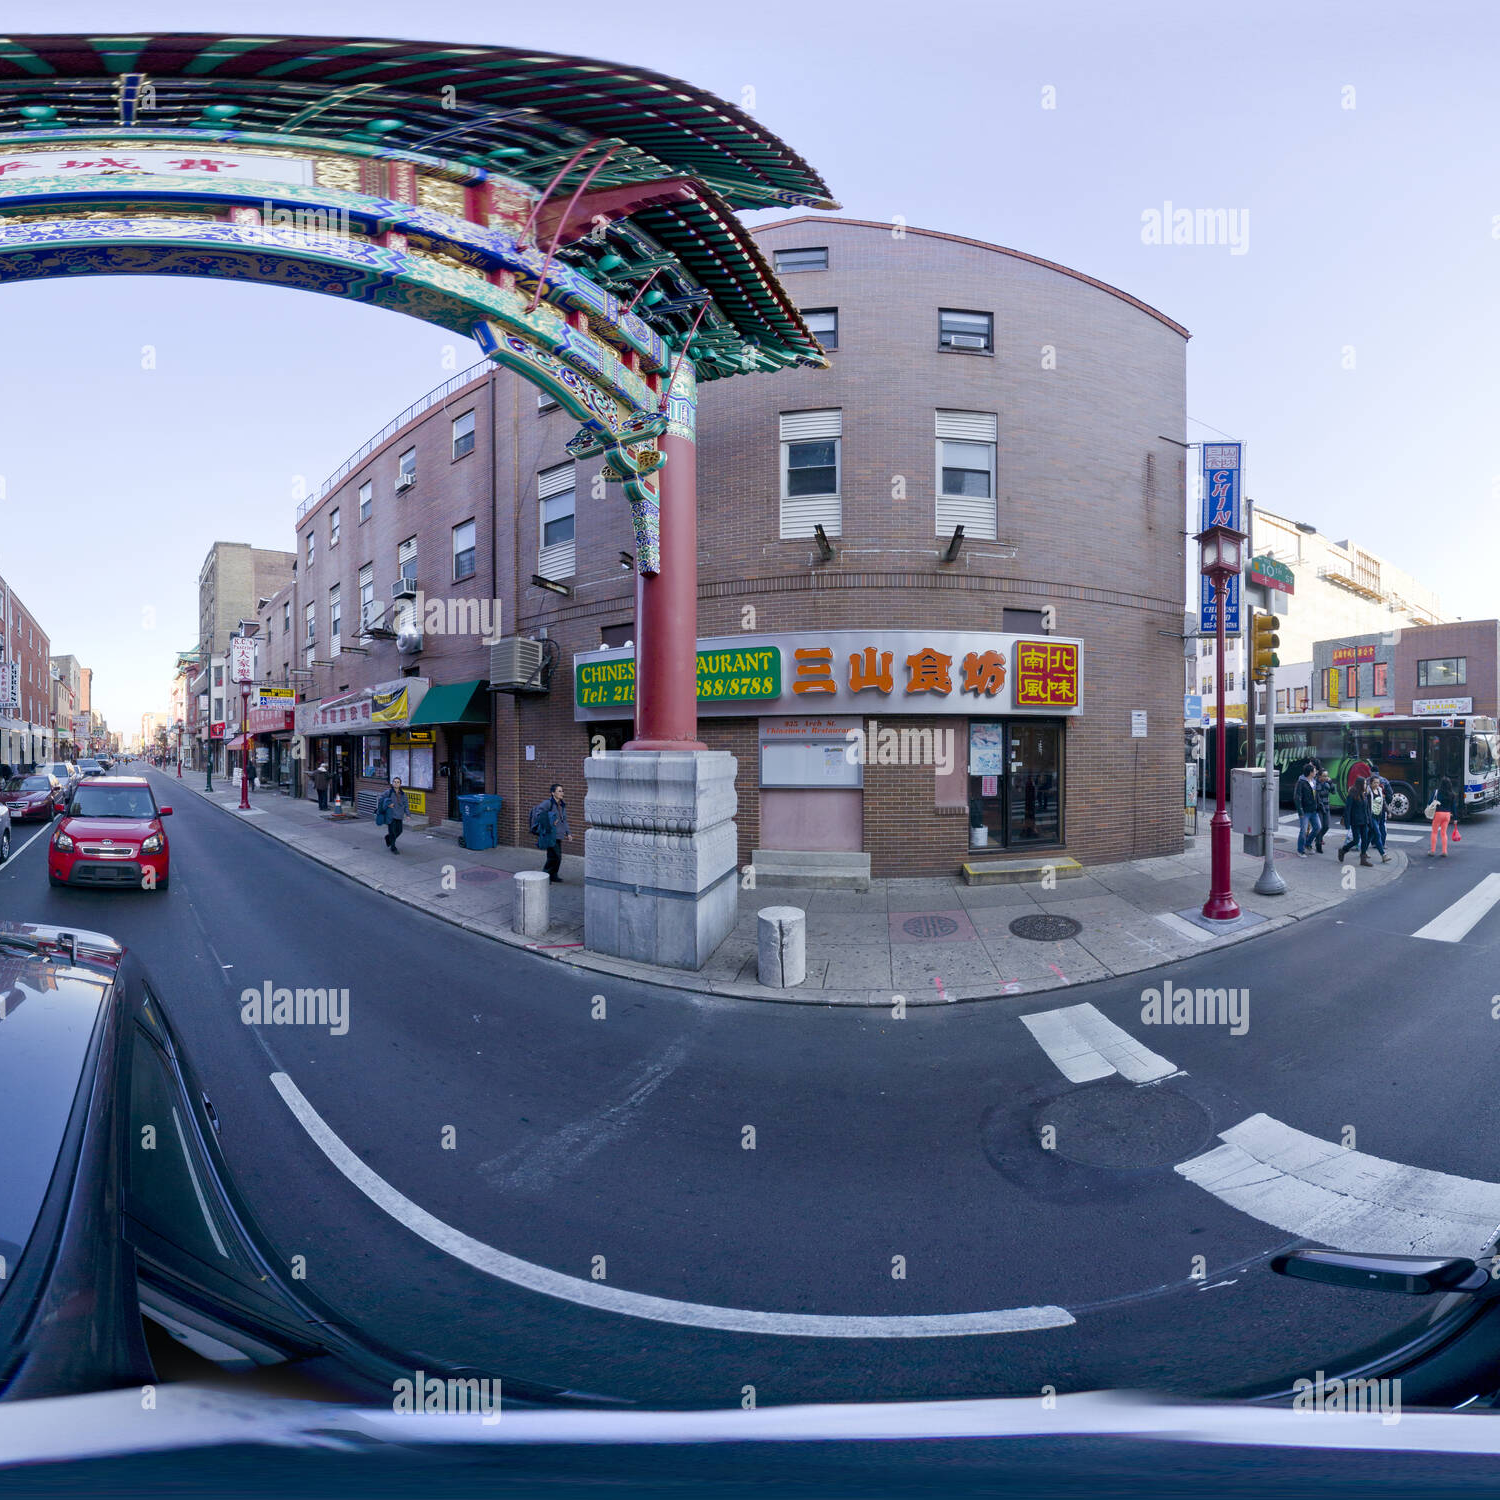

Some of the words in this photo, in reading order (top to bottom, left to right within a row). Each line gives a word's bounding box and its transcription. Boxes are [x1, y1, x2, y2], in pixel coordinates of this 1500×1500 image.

[581, 661, 635, 684] CHINES
[696, 651, 773, 675] AURANT
[792, 646, 1007, 695] 三山食坊
[581, 687, 608, 704] Tel:
[1274, 733, 1297, 743] ONIGHT
